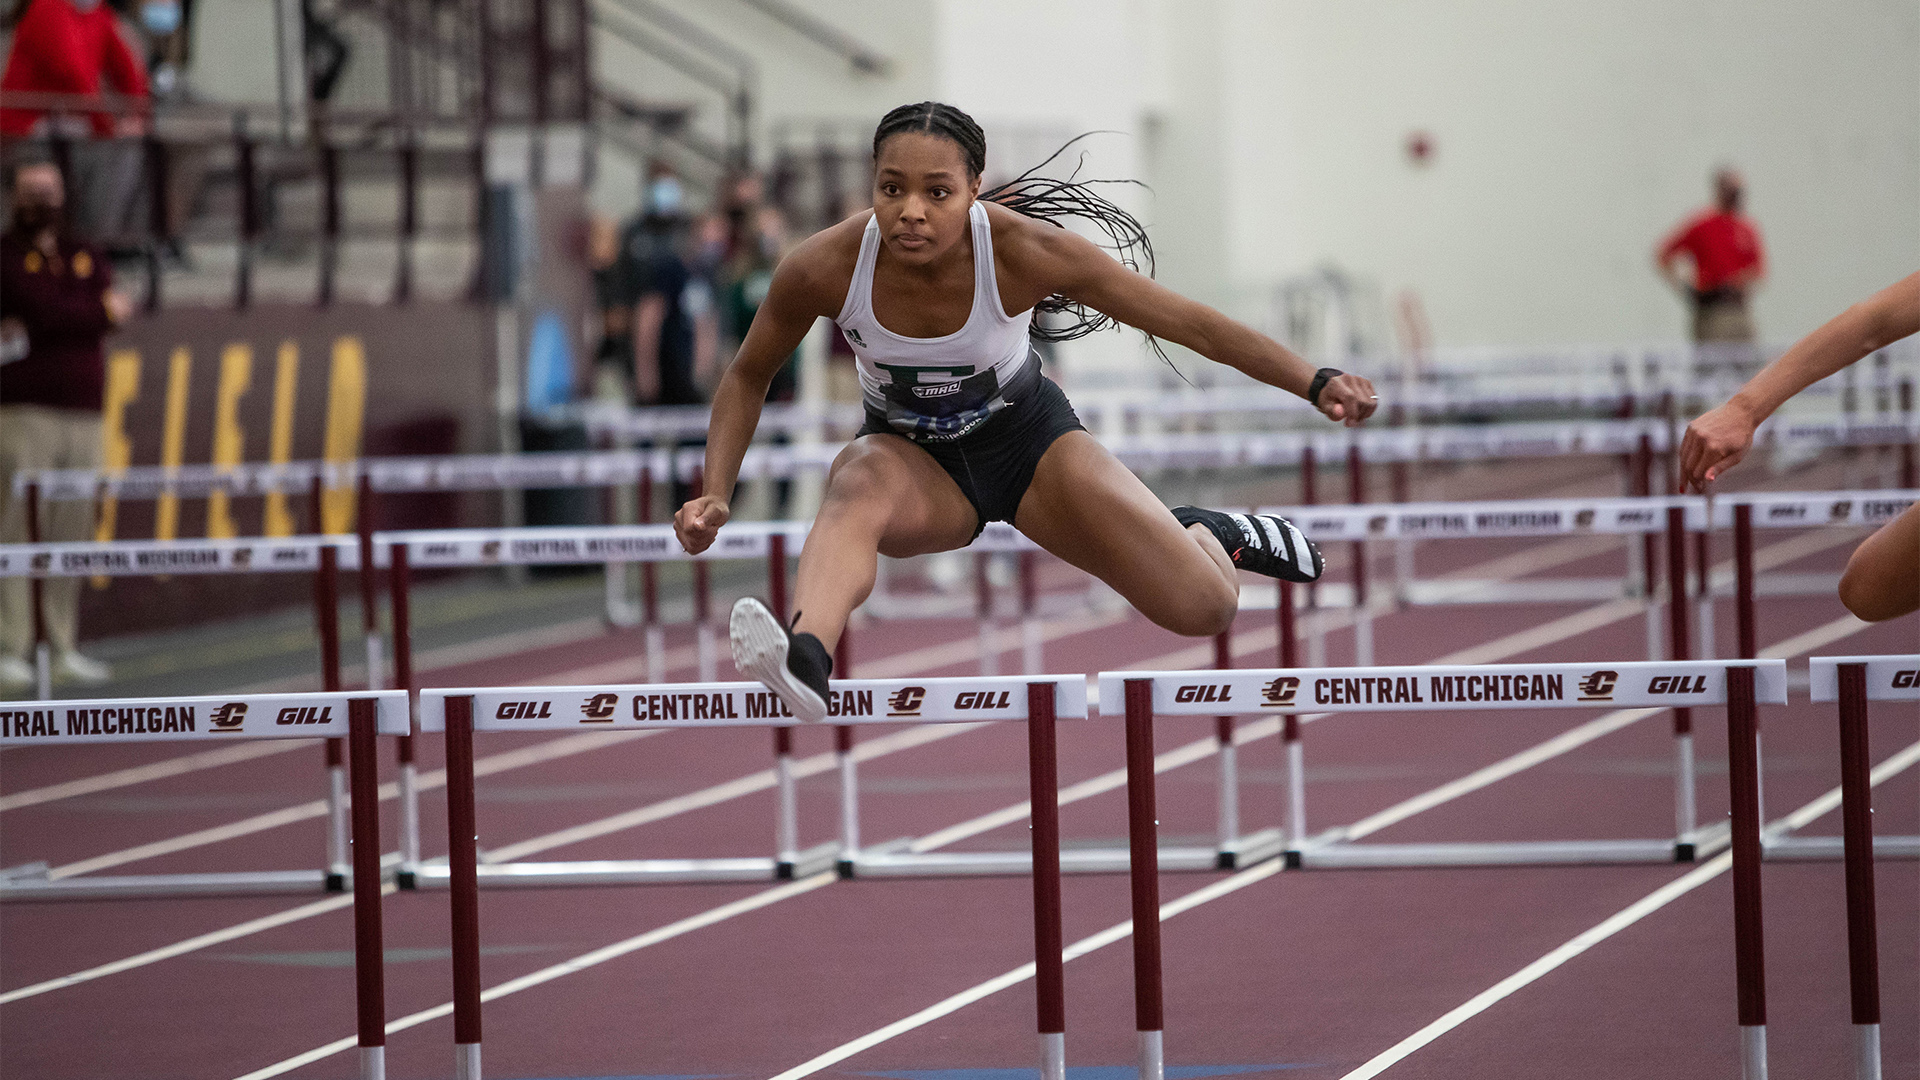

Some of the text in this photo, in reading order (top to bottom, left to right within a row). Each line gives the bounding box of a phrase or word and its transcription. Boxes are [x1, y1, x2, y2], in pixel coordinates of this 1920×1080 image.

[925, 383, 958, 396] MAC
[1175, 685, 1232, 703] GILL
[1314, 674, 1563, 705] CENTRAL MICHIGAN
[1648, 675, 1707, 694] GILL
[632, 690, 873, 721] CENTRAL MIGAN
[953, 691, 1010, 709] GILL
[276, 707, 333, 725] GILL
[495, 701, 551, 720] GILL
[67, 706, 195, 735] MICHIGAN
